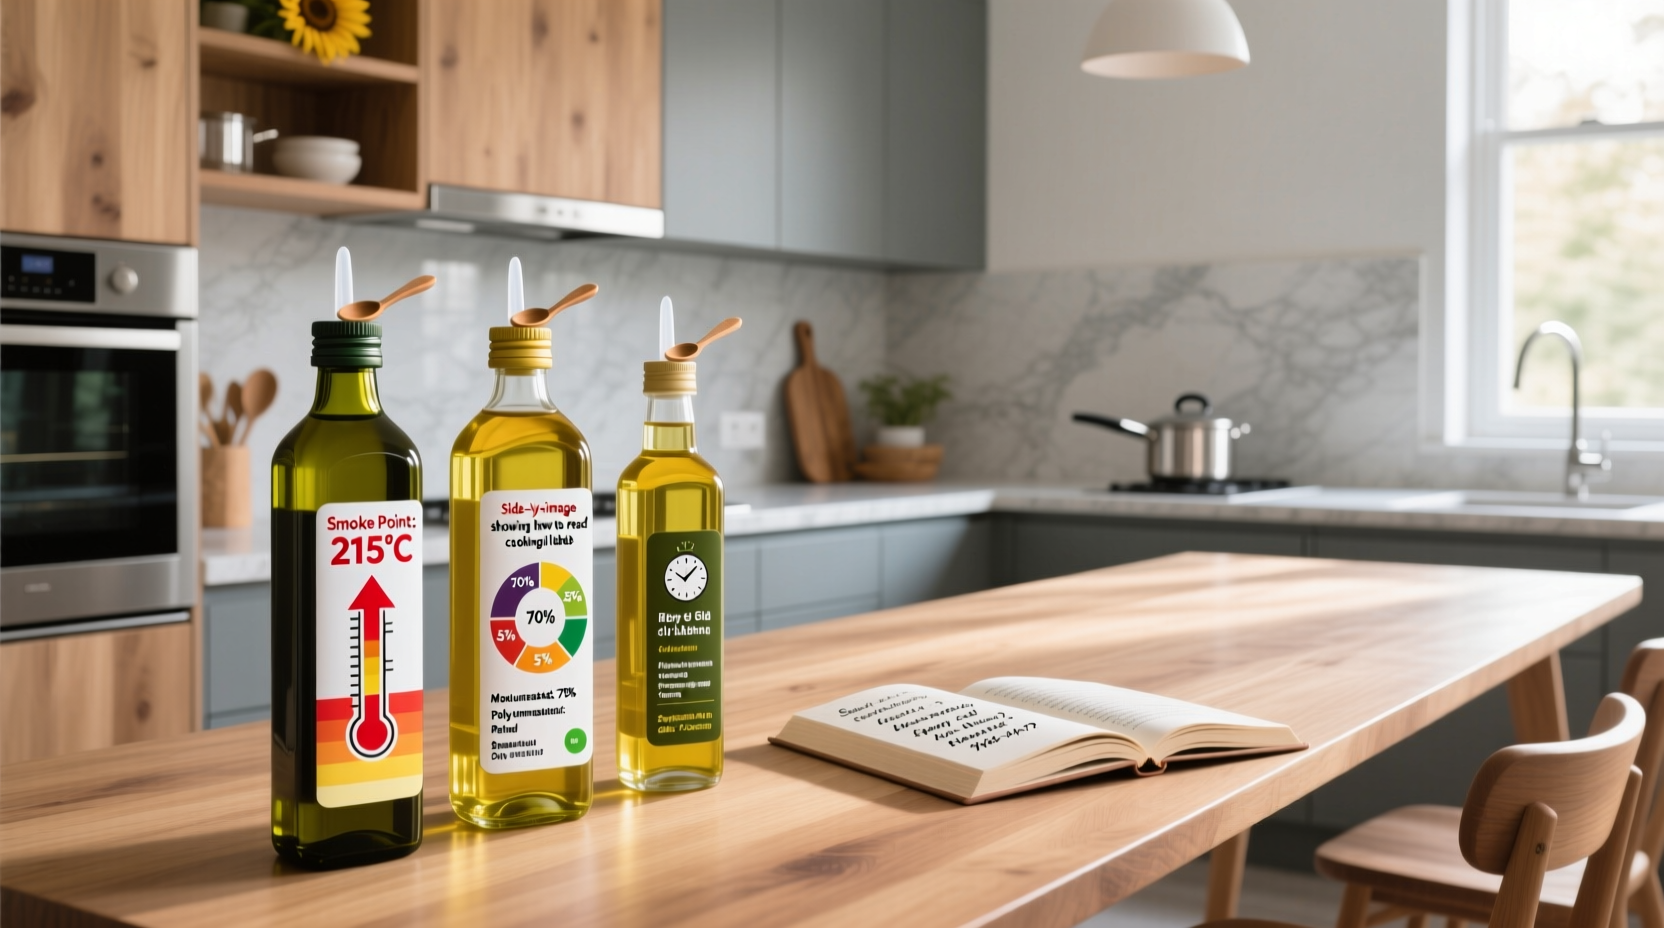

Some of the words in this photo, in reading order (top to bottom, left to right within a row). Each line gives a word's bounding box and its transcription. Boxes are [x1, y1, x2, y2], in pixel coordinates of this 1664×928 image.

[327, 515, 374, 531] Smoke
[378, 514, 416, 529] Point:
[331, 533, 413, 565] 215°C
[526, 609, 556, 625] 70%
[496, 629, 516, 642] 5%
[533, 652, 553, 667] 5%
